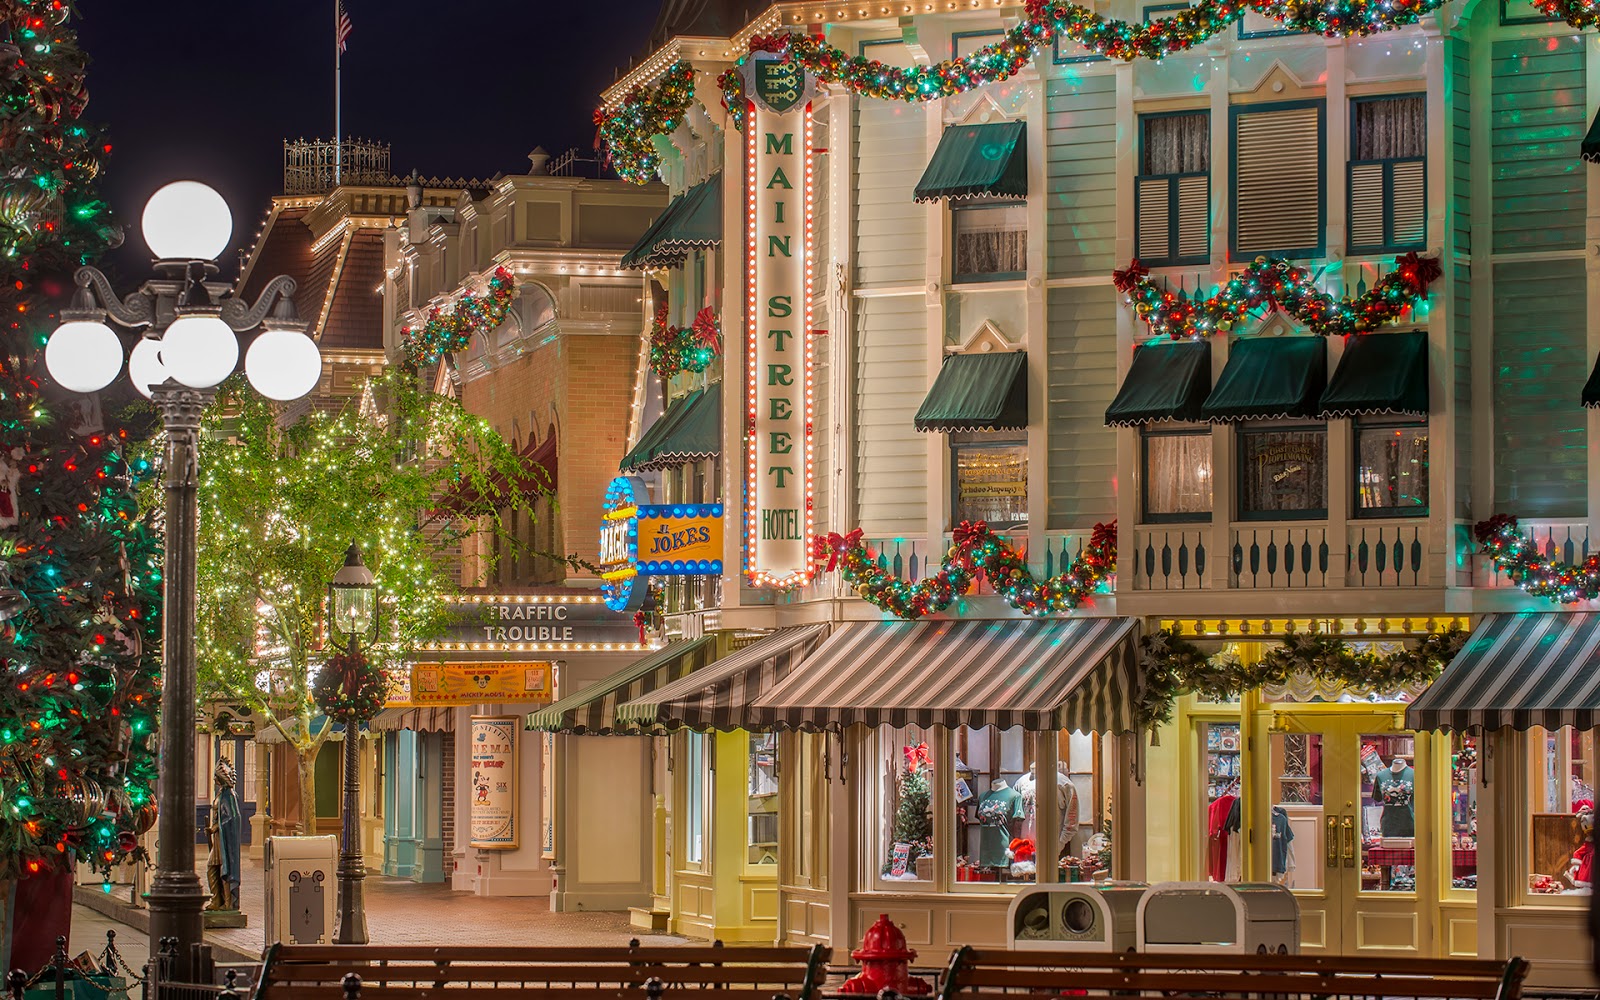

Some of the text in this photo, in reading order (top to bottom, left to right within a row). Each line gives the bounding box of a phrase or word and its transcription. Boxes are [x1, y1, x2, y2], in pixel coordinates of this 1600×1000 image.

[765, 133, 794, 488] MAIN STREET
[762, 508, 802, 540] HOTEL
[600, 521, 628, 565] MAGIC
[650, 526, 711, 554] JOKES
[487, 606, 567, 620] TRAFFIC
[484, 626, 573, 641] TROUBLE
[472, 744, 511, 753] NEMA
